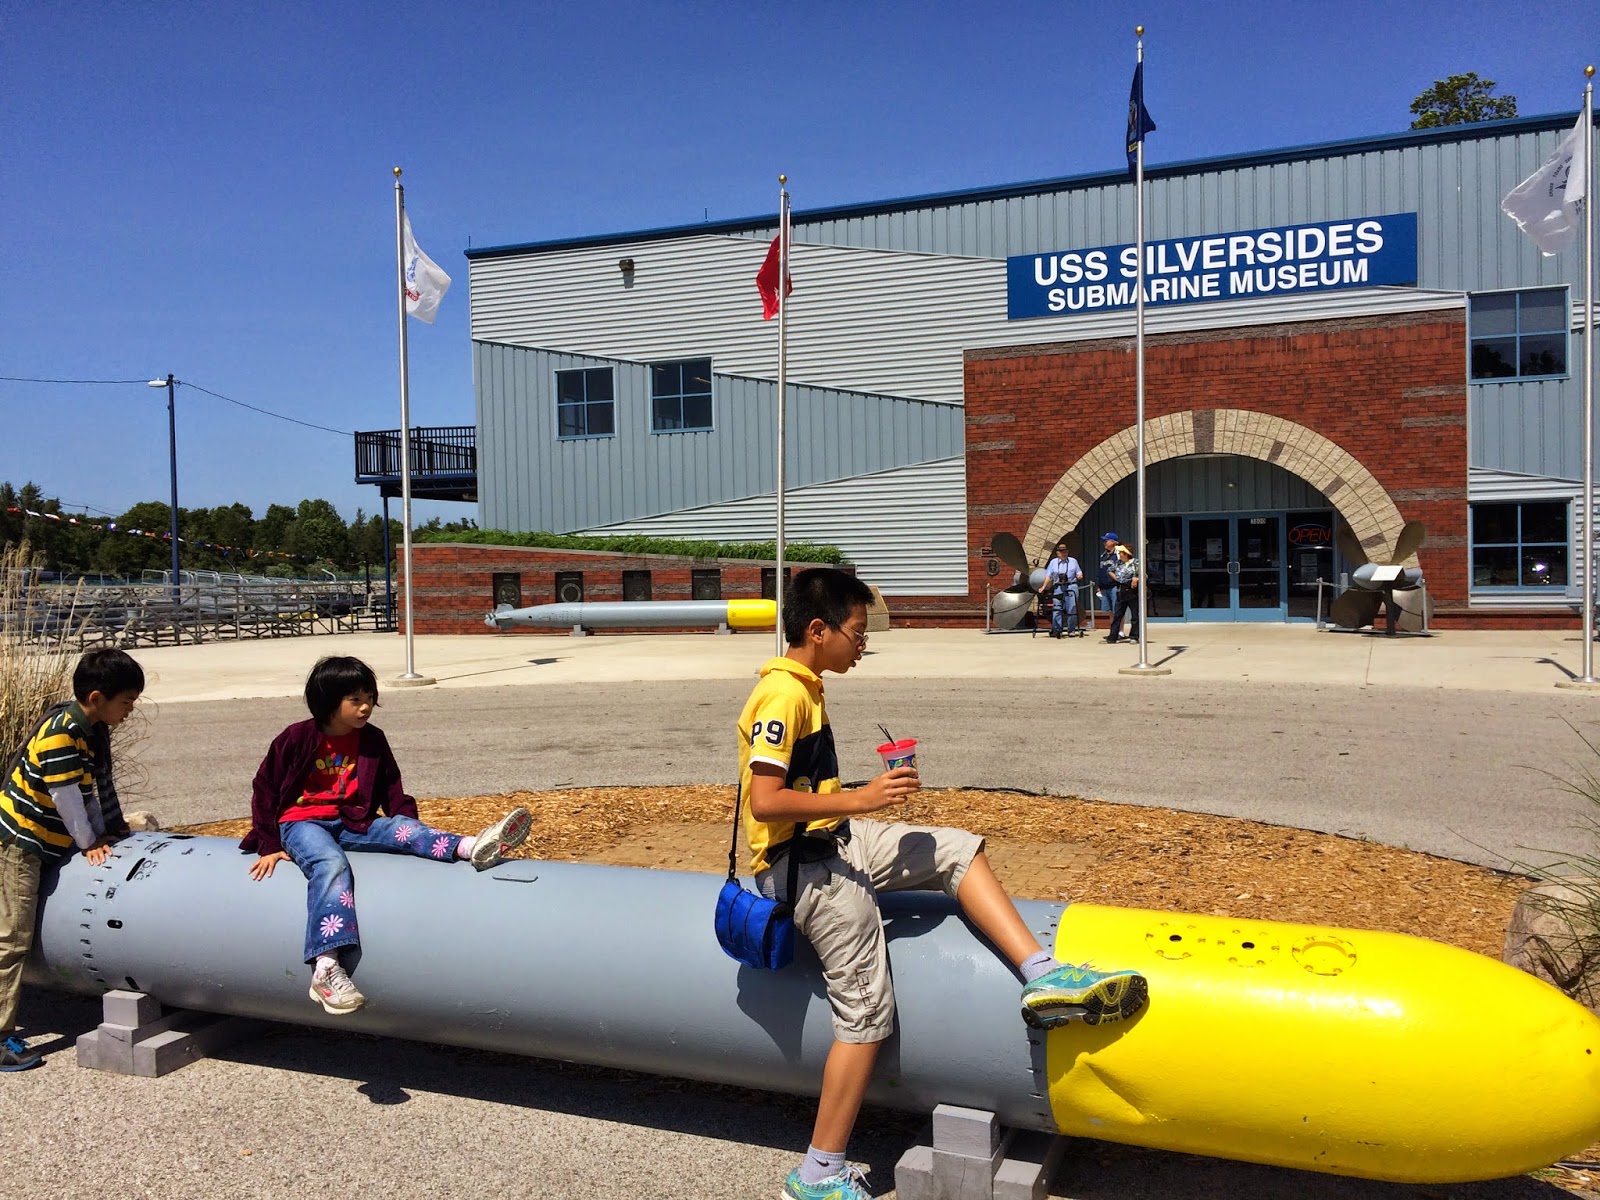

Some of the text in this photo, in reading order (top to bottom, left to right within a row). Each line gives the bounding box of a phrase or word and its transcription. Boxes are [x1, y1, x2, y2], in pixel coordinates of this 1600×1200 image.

[1034, 220, 1384, 286] USS SILVERSIDES
[1048, 258, 1369, 312] SUBMARINE MUSEUM
[1288, 526, 1332, 544] OPEN
